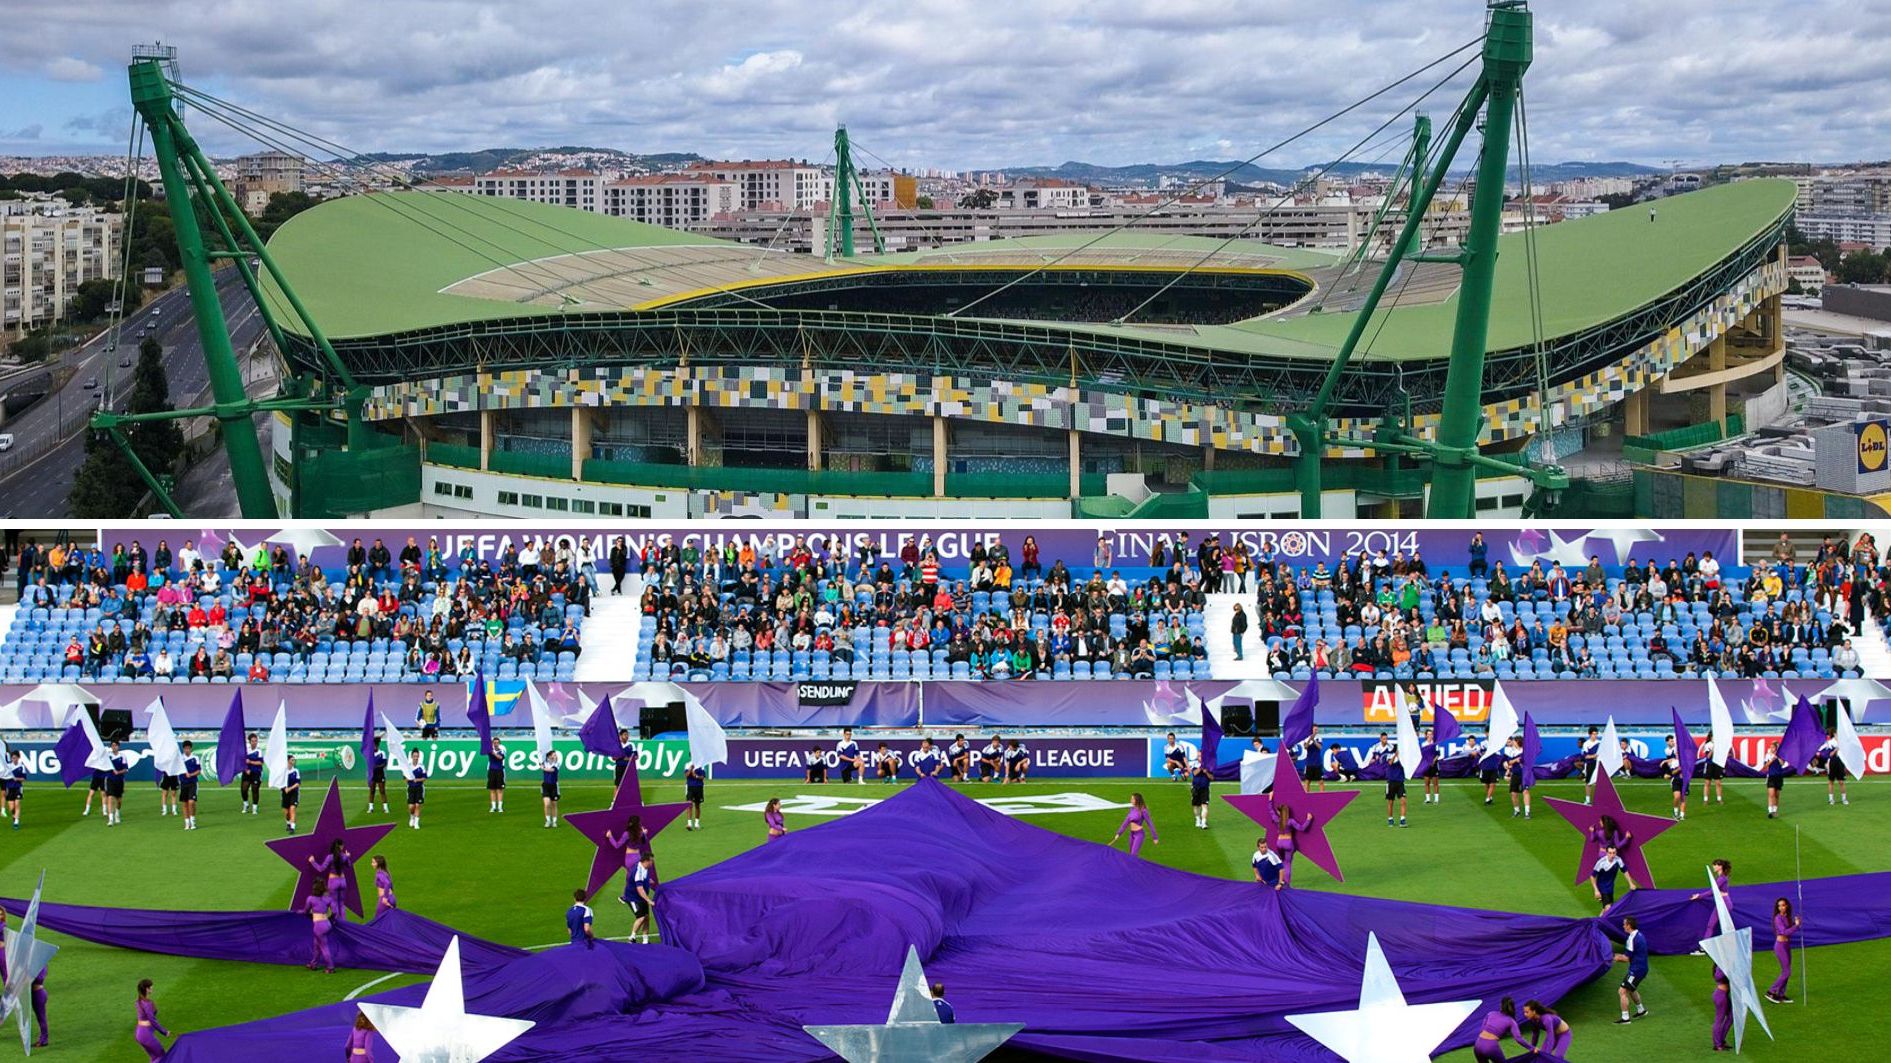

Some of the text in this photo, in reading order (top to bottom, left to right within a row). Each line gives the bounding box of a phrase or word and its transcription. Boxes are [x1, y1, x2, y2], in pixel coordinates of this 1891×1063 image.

[430, 534, 516, 560] UEFA
[682, 533, 870, 559] CHAMPONS
[880, 533, 1000, 558] LEAGUE
[1210, 531, 1330, 557] ISBON
[1346, 531, 1420, 557] 2014
[1369, 683, 1485, 717] ARIED
[386, 743, 684, 778] Ejoy esonsbly
[744, 751, 801, 768] UEFA
[1036, 749, 1115, 767] LEAGUE
